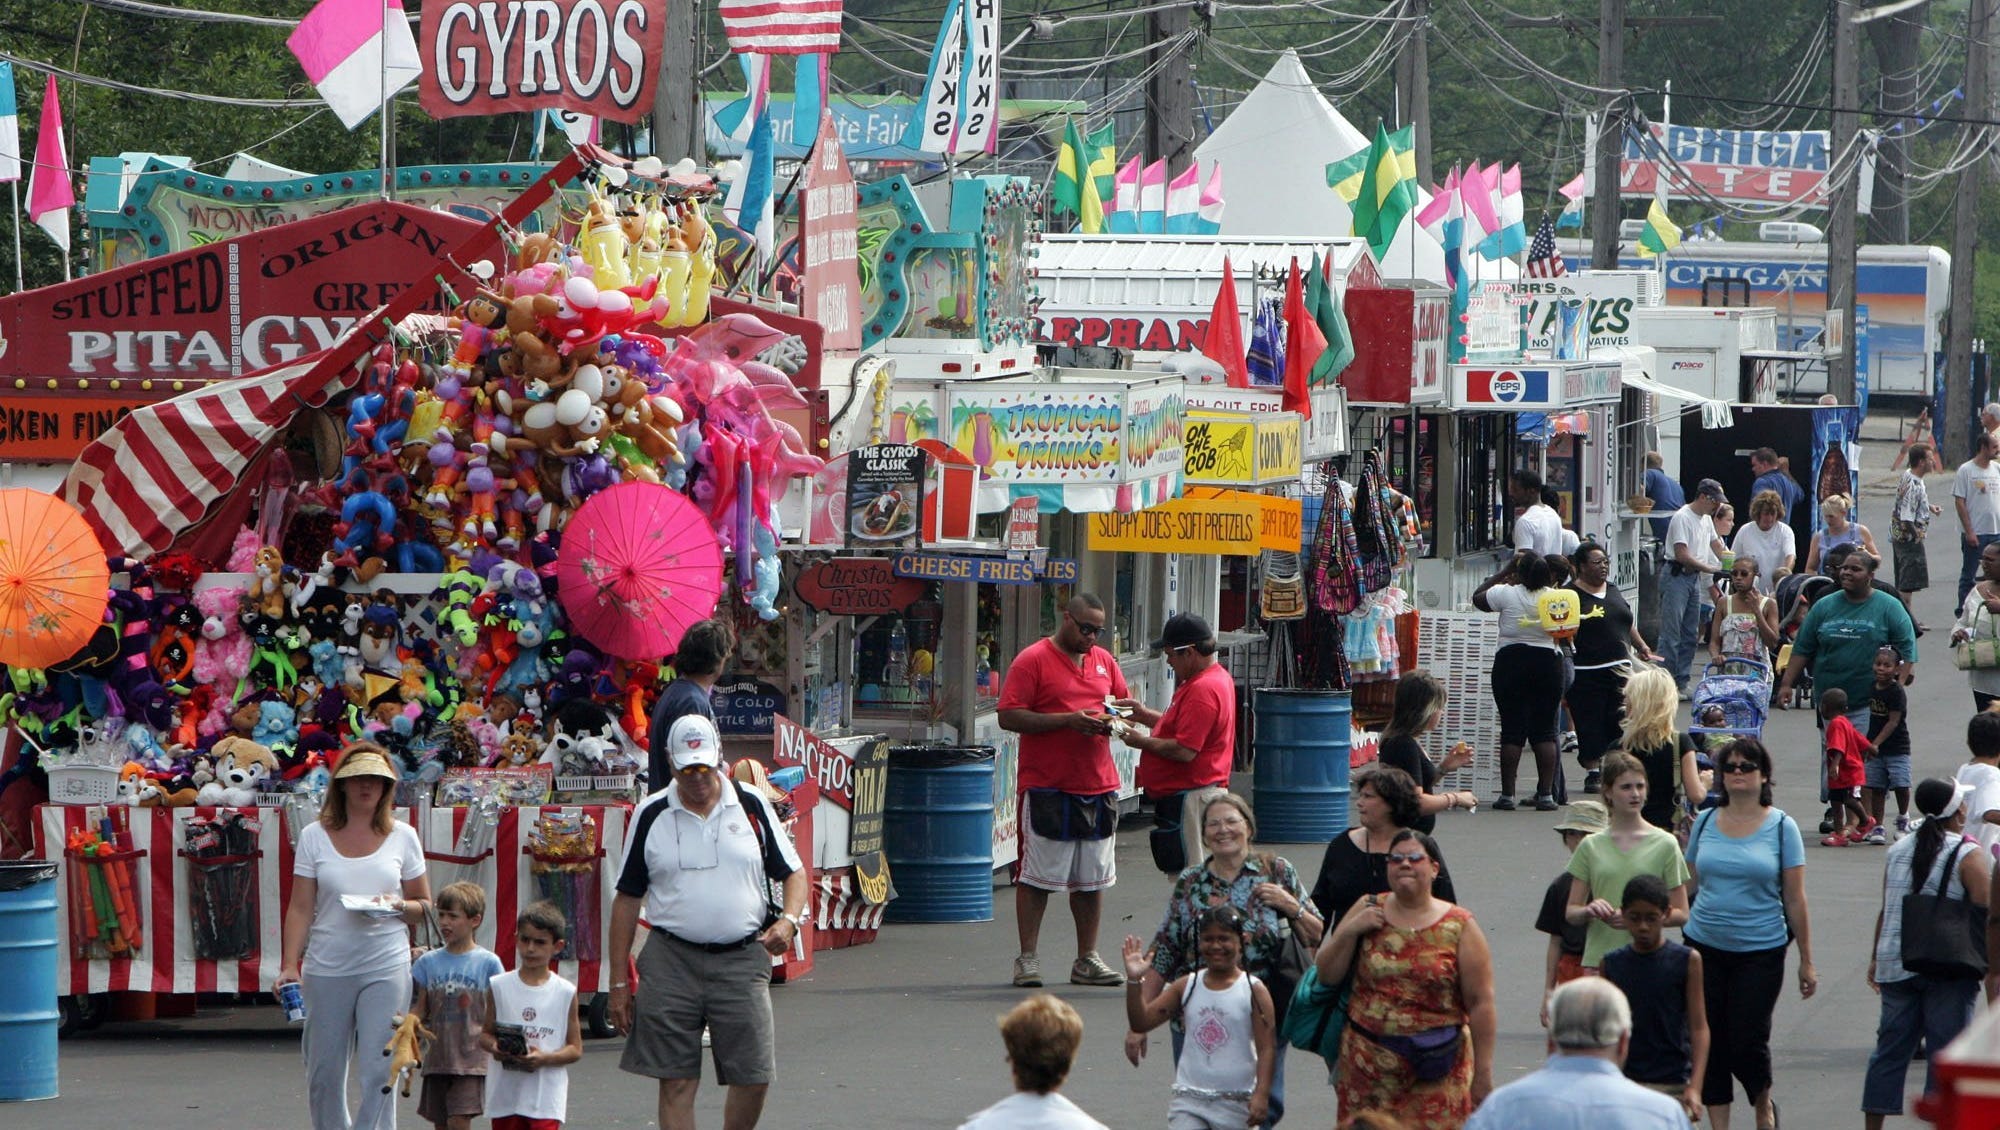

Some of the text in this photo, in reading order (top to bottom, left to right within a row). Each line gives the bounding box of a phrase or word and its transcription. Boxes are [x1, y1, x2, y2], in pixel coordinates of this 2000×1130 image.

[436, 0, 648, 108] GYROS
[52, 251, 224, 320] STUFFED
[68, 331, 234, 373] PITA
[1532, 338, 1549, 348] NO
[1494, 381, 1521, 392] PEPSI
[1007, 402, 1121, 433] TROPICAL
[1184, 434, 1212, 457] THE
[1186, 422, 1210, 443] ON
[857, 446, 919, 459] THE GYROS
[866, 458, 908, 471] CLASSIC
[1014, 439, 1104, 471] DRINKS
[1184, 446, 1217, 476] COB
[1259, 431, 1282, 470] CORN
[1098, 510, 1140, 539] SLOPPY
[1203, 513, 1253, 542] PRETZELS
[818, 564, 897, 590] Christos
[898, 555, 1033, 581] CHEESE FRIES
[831, 588, 892, 608] GYROS
[735, 697, 775, 709] COLD
[779, 723, 854, 799] NACHOS
[853, 767, 876, 815] PITA
